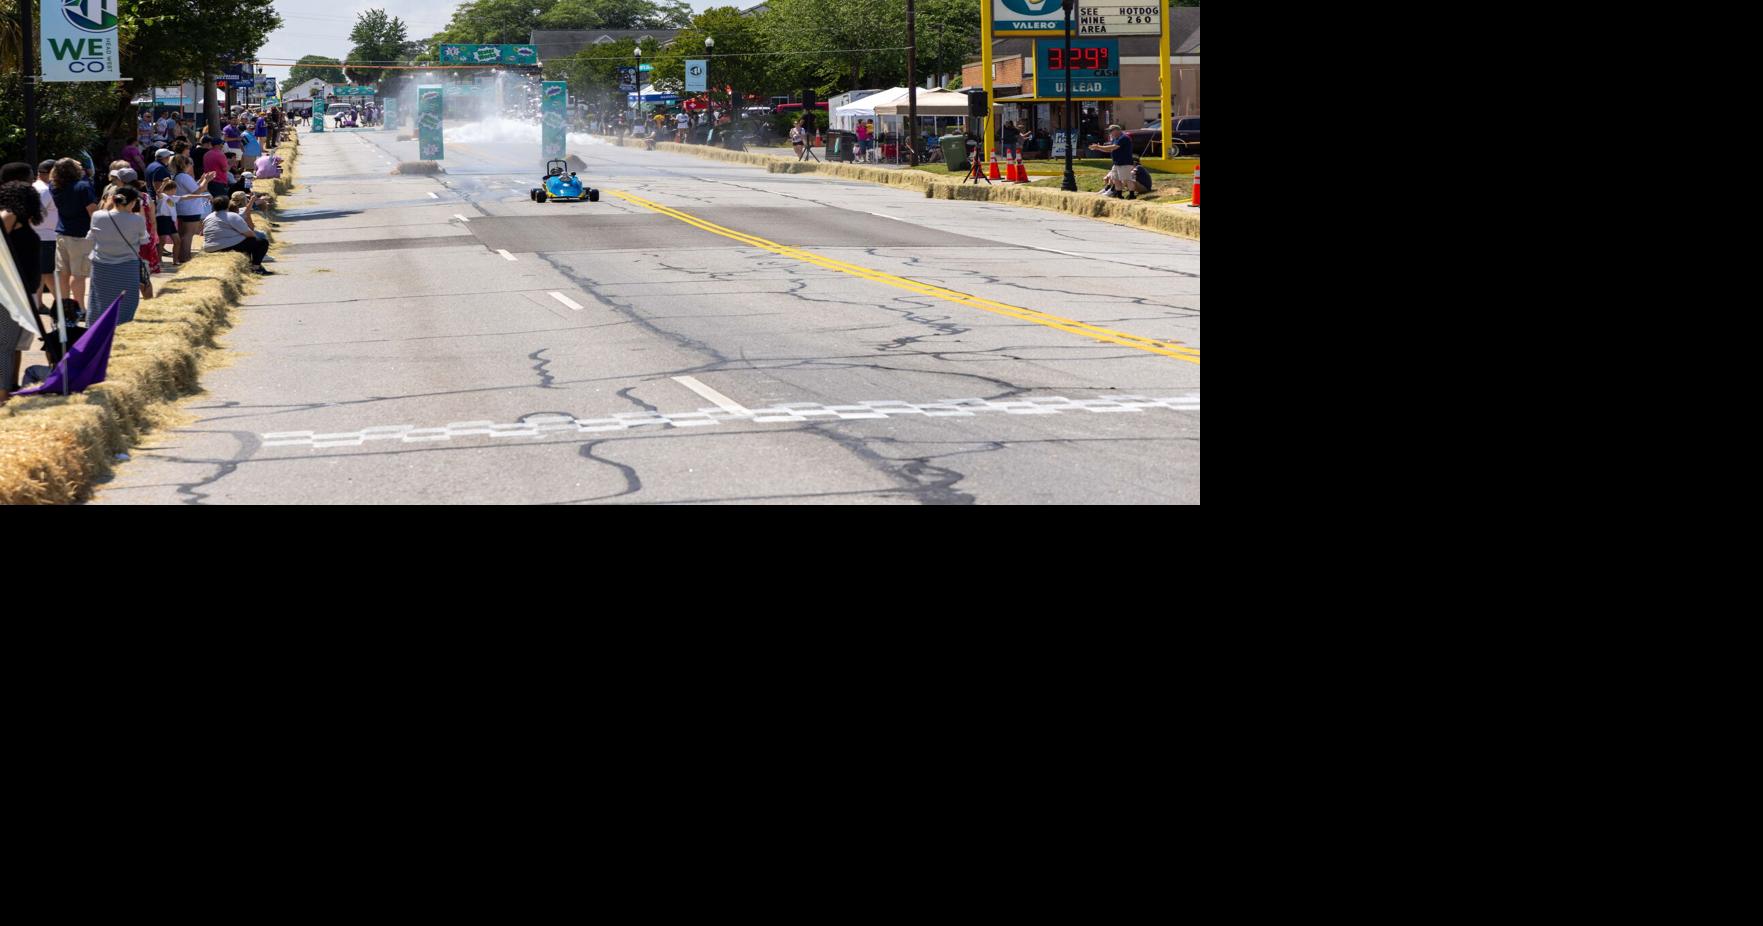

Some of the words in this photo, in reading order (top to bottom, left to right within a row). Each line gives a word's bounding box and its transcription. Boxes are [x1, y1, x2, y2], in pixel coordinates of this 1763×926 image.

[1120, 7, 1159, 15] HOTDOG
[1081, 16, 1105, 24] WINE
[1012, 21, 1056, 29] VALERO
[1081, 25, 1107, 33] AREA
[47, 38, 103, 60] WE
[69, 61, 104, 73] CO
[1055, 82, 1102, 92] ULEAD
